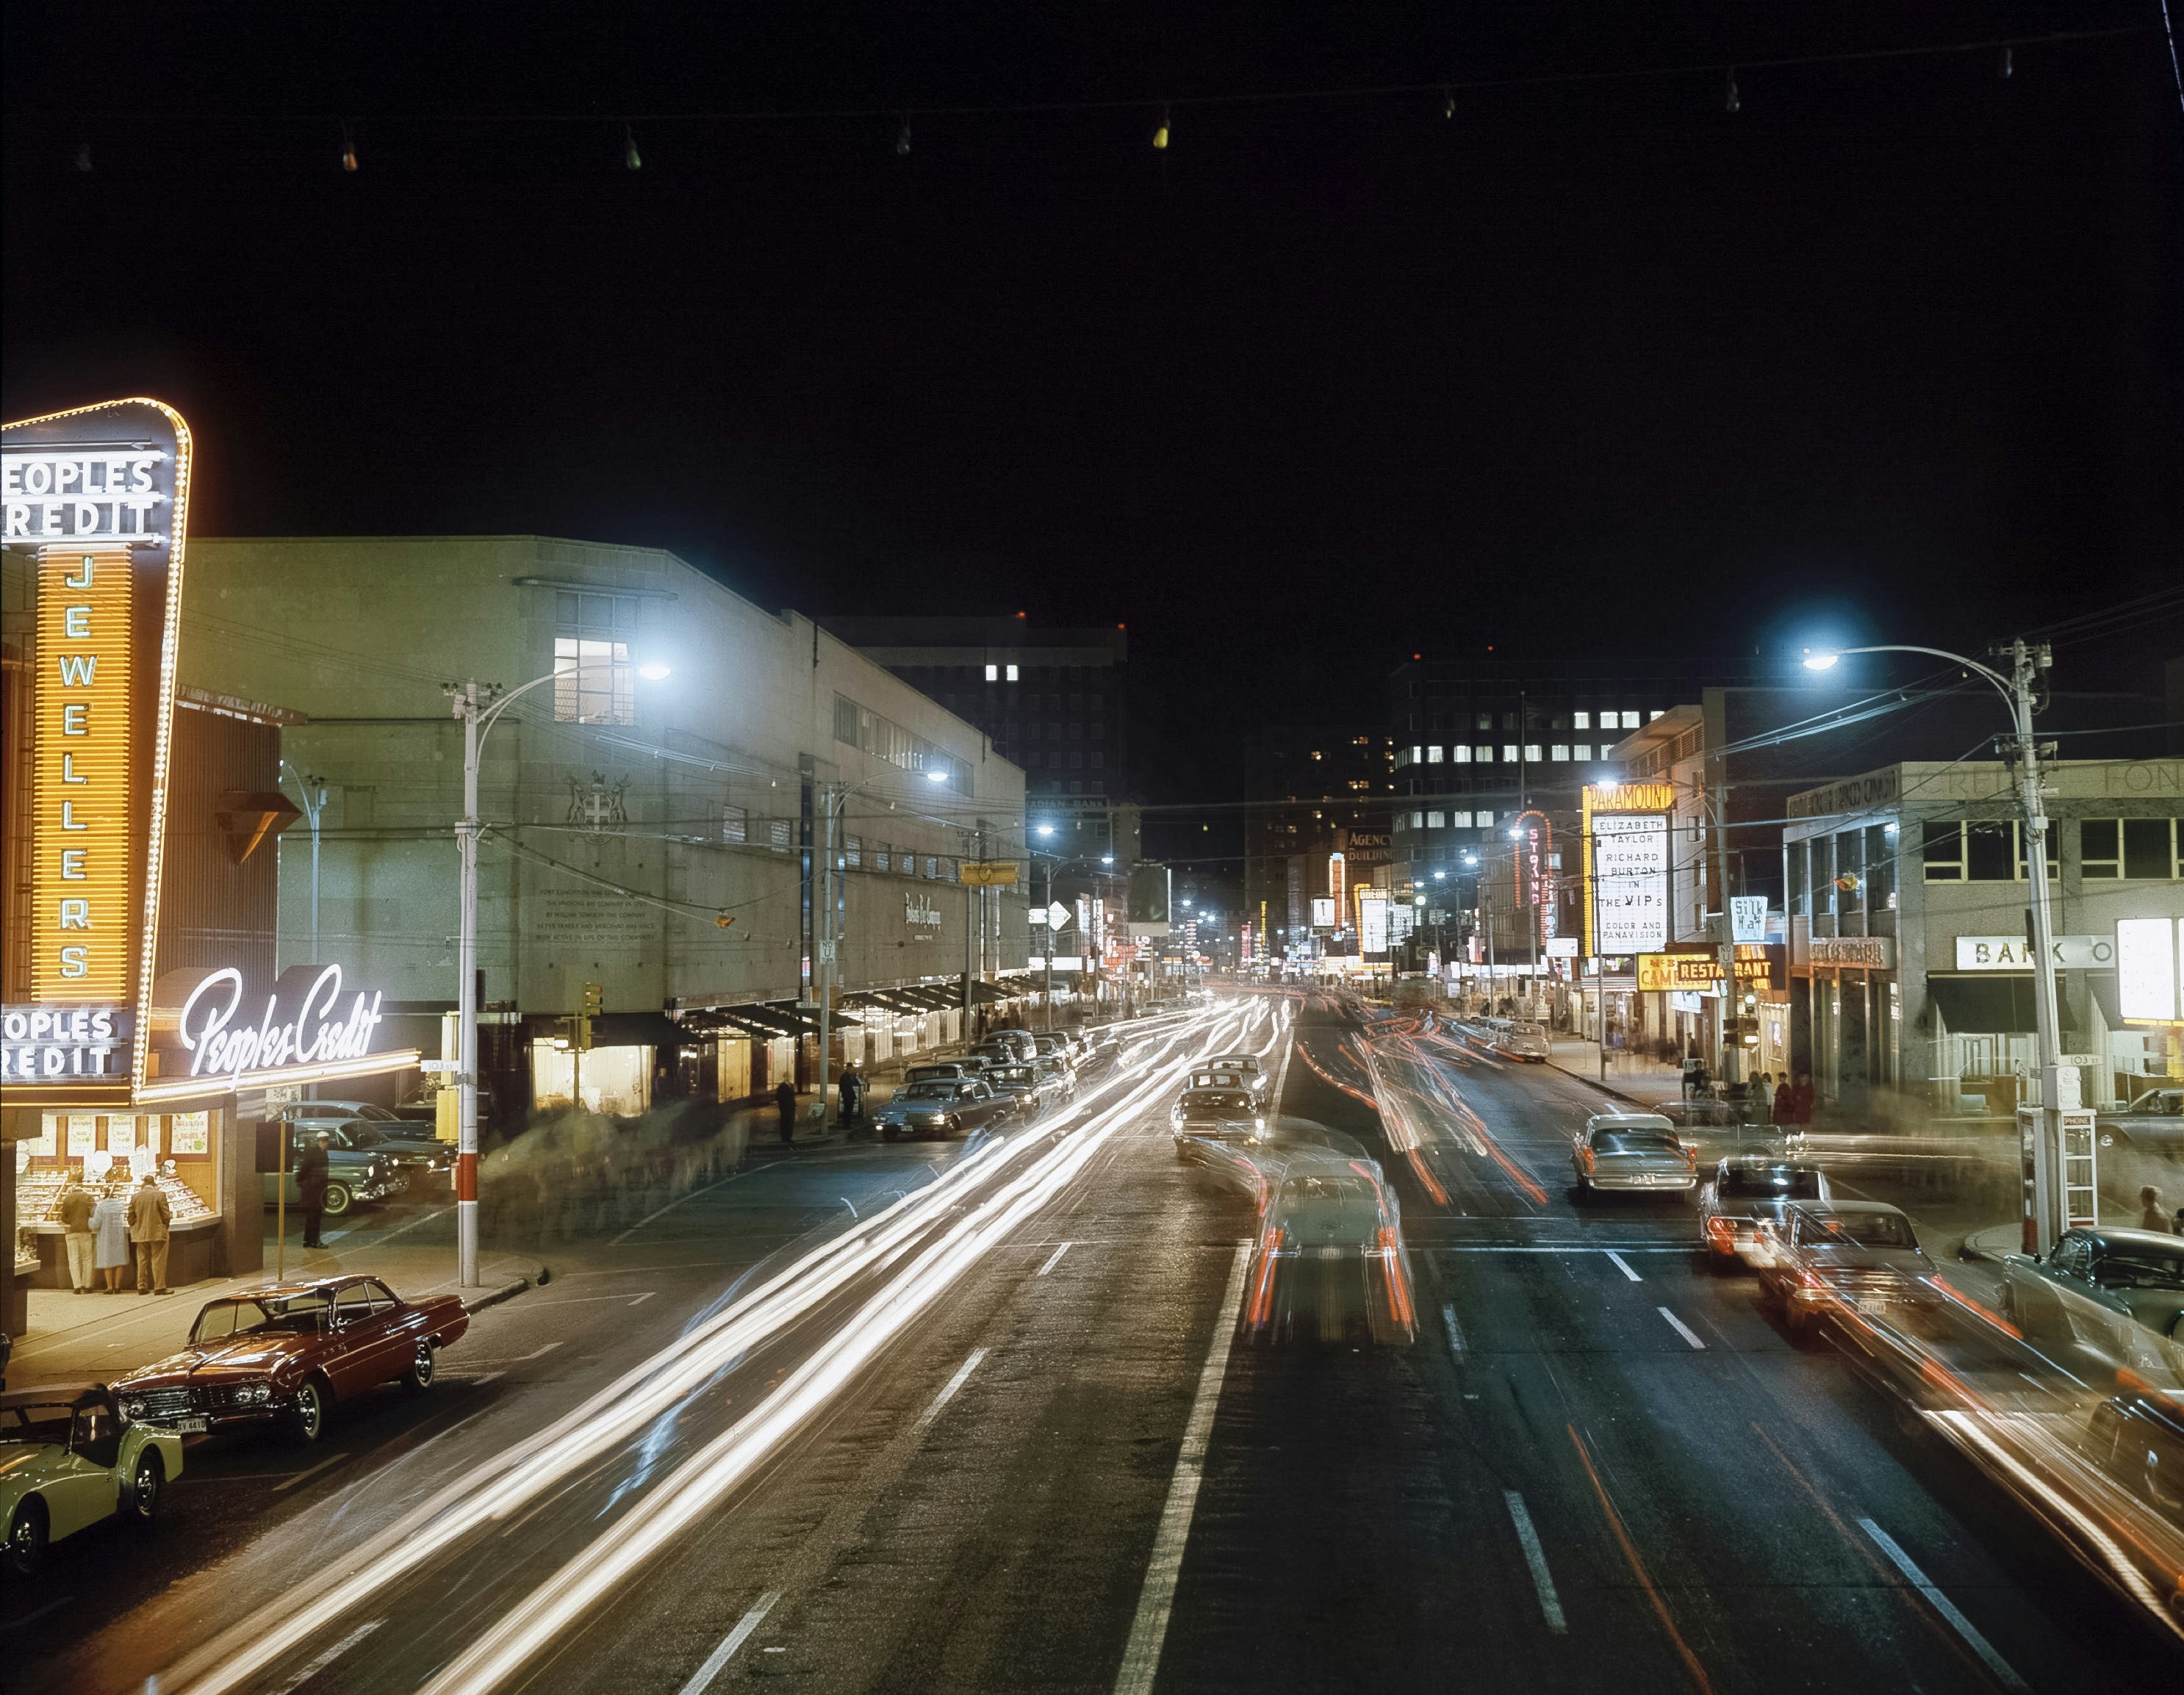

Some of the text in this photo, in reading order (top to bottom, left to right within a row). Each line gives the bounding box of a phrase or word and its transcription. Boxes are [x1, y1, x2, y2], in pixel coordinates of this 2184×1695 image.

[2, 459, 153, 495] EOPLES
[6, 500, 154, 536] REDIT
[59, 555, 98, 979] JEWELLERS
[1590, 784, 1672, 811] PARAMOUNT
[1073, 799, 1104, 808] BANK
[1599, 820, 1663, 830] ELIZABETH
[1349, 830, 1393, 846] AGENCY
[1611, 835, 1653, 843] TAYLOR
[1606, 853, 1659, 862] RICHARD
[1611, 866, 1656, 876] BURTON
[1628, 880, 1639, 888] IN
[1599, 899, 1620, 907] THE
[1736, 900, 1763, 915] Silk
[1606, 922, 1637, 930] COLOR
[1738, 913, 1761, 929] Hat
[1602, 931, 1662, 939] PANAVISION
[824, 949, 831, 957] U
[1720, 945, 1731, 953] NO
[1975, 941, 2066, 963] BANK
[1723, 952, 1730, 962] U
[1681, 962, 1772, 979] RESTARANT
[6, 1012, 112, 1040] OPLES
[179, 962, 382, 1093] Peoples Credit
[2069, 1056, 2088, 1065] 103
[428, 1062, 444, 1070] 103
[2065, 1117, 2089, 1125] PHONE
